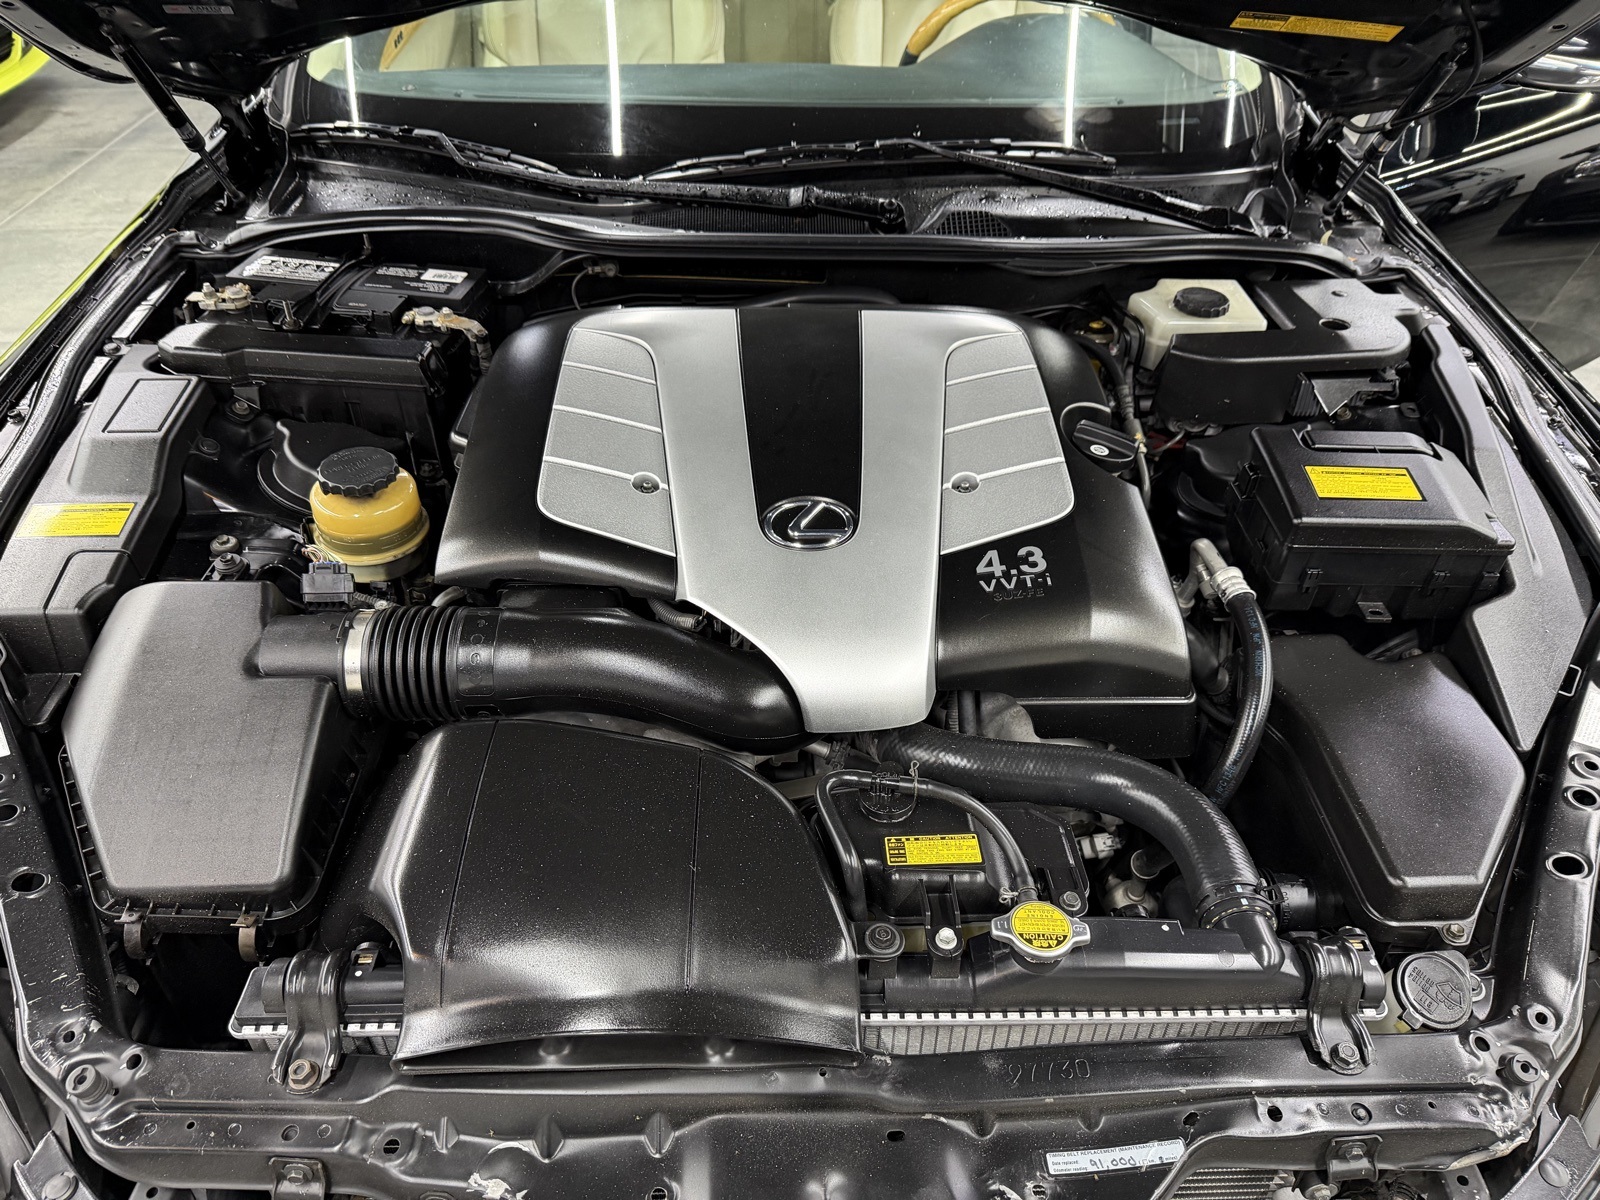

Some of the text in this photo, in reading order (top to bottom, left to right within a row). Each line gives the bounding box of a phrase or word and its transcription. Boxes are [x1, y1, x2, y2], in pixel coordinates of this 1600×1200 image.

[976, 545, 1047, 577] 4.3
[979, 573, 1052, 592] VVT-i
[1023, 933, 1064, 941] CAUTION
[1080, 1148, 1117, 1156] REPLACEMENT
